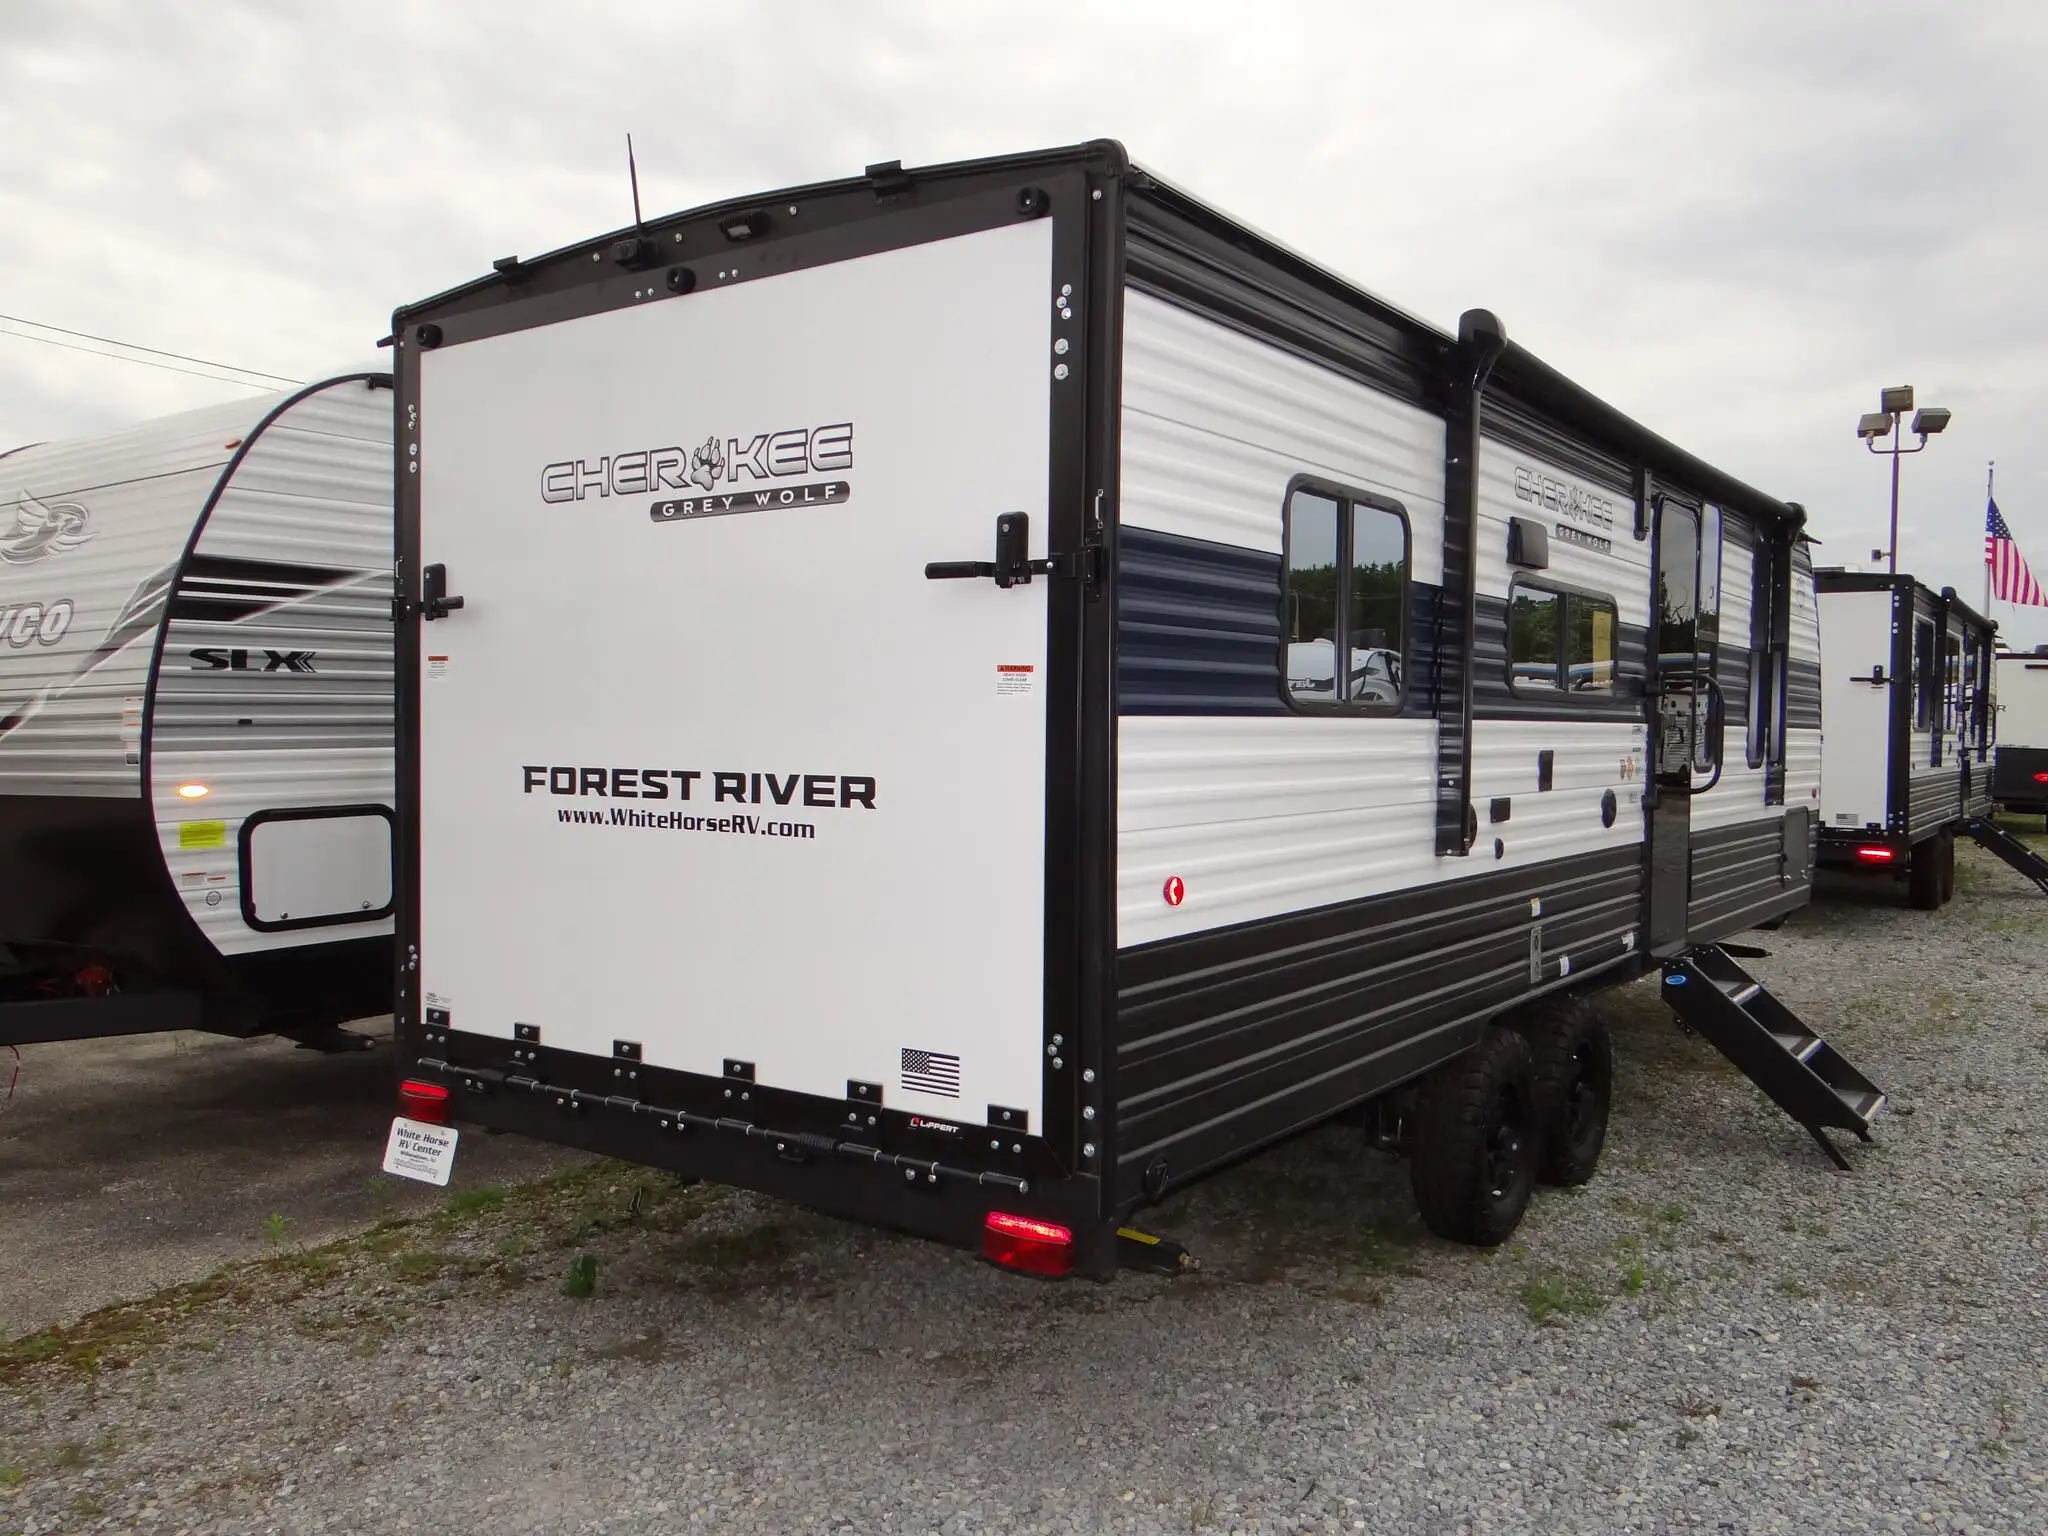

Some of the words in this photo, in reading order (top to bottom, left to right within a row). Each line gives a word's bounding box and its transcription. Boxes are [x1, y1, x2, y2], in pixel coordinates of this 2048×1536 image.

[662, 497, 732, 518] GREY
[754, 484, 837, 507] WOLF
[189, 648, 318, 672] SLX
[522, 765, 702, 801] FOREST
[712, 771, 877, 810] RIVER
[557, 807, 816, 839] www.WhiteHorseRV.com
[396, 1127, 422, 1141] White
[423, 1133, 450, 1148] Horse
[398, 1139, 412, 1150] RV
[412, 1142, 443, 1157] Center
